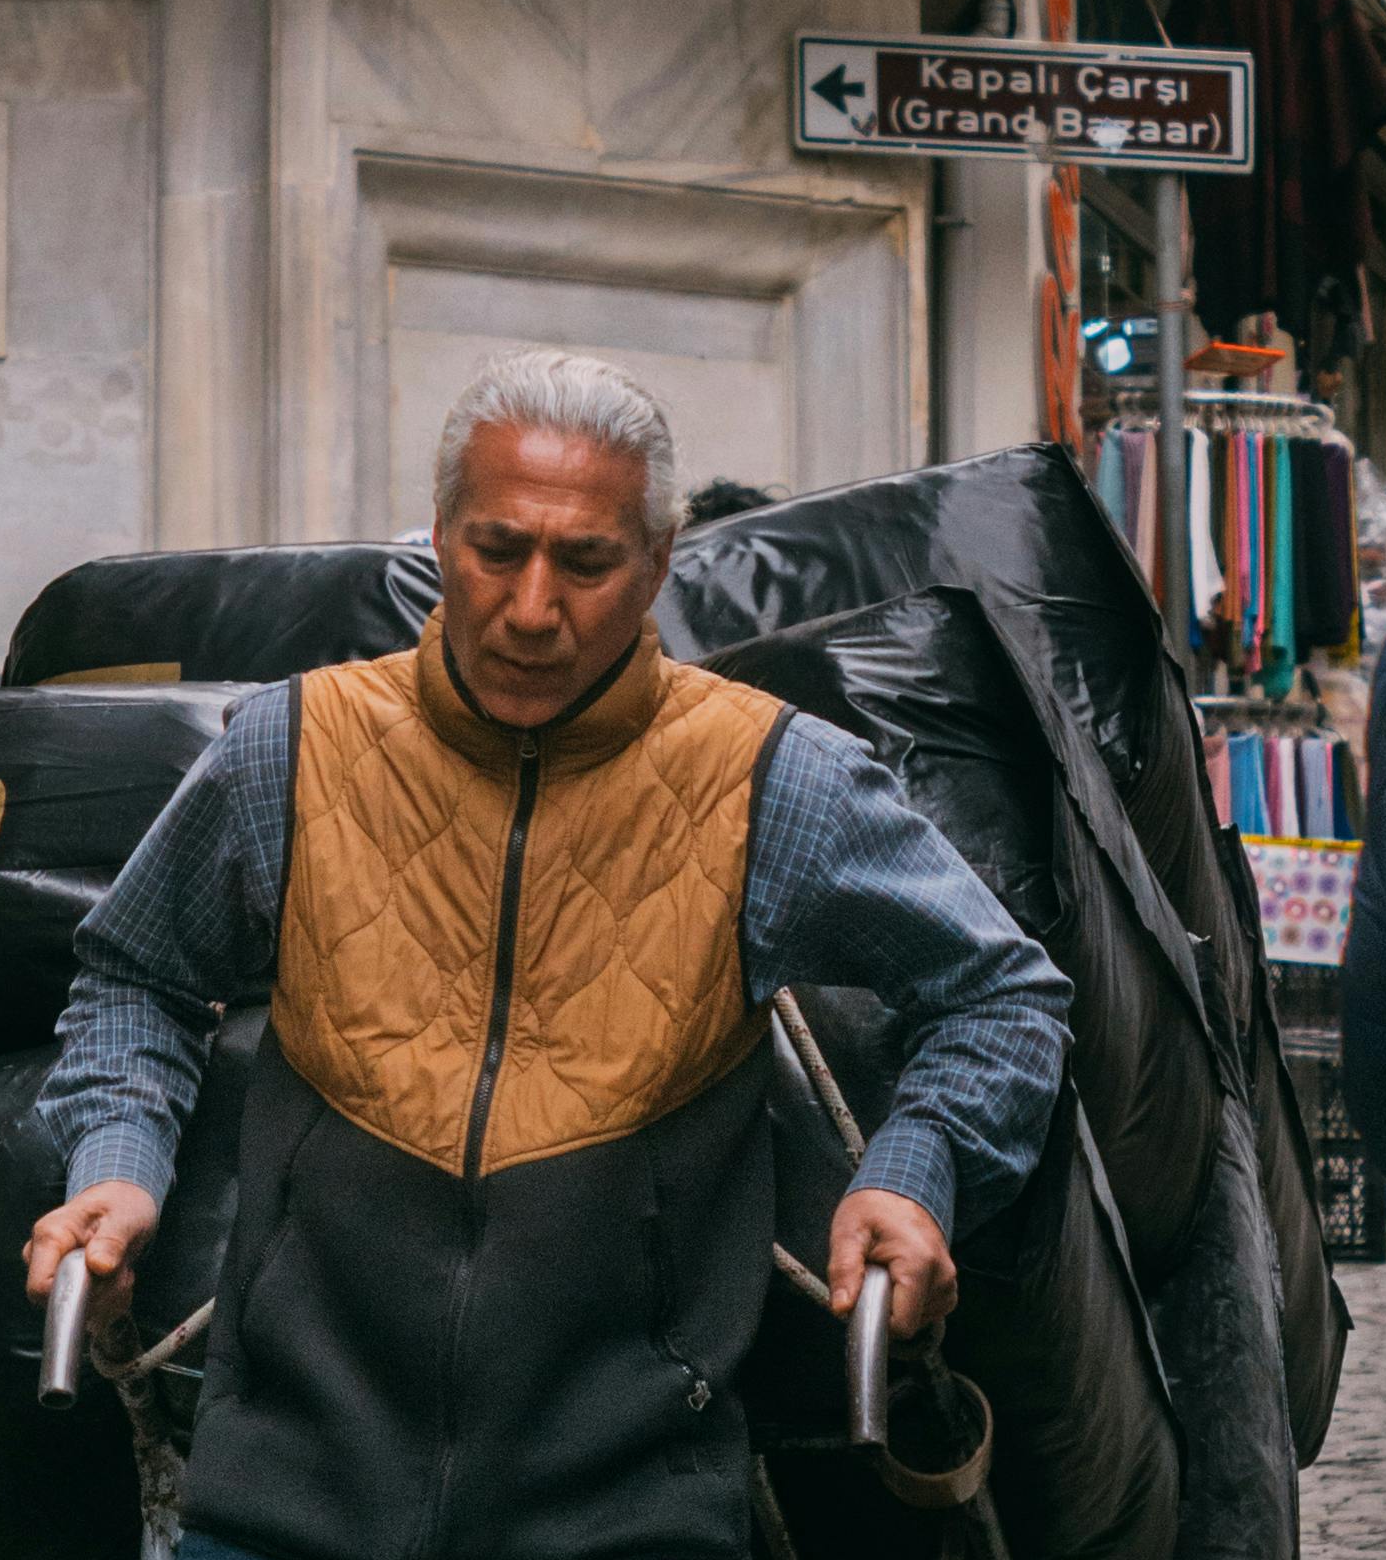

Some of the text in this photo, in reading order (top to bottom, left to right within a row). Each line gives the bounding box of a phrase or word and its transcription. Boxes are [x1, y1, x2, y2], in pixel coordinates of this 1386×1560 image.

[920, 56, 1189, 104] Kapalı Çarşı
[889, 95, 1222, 151] (Grand Bazaar)
